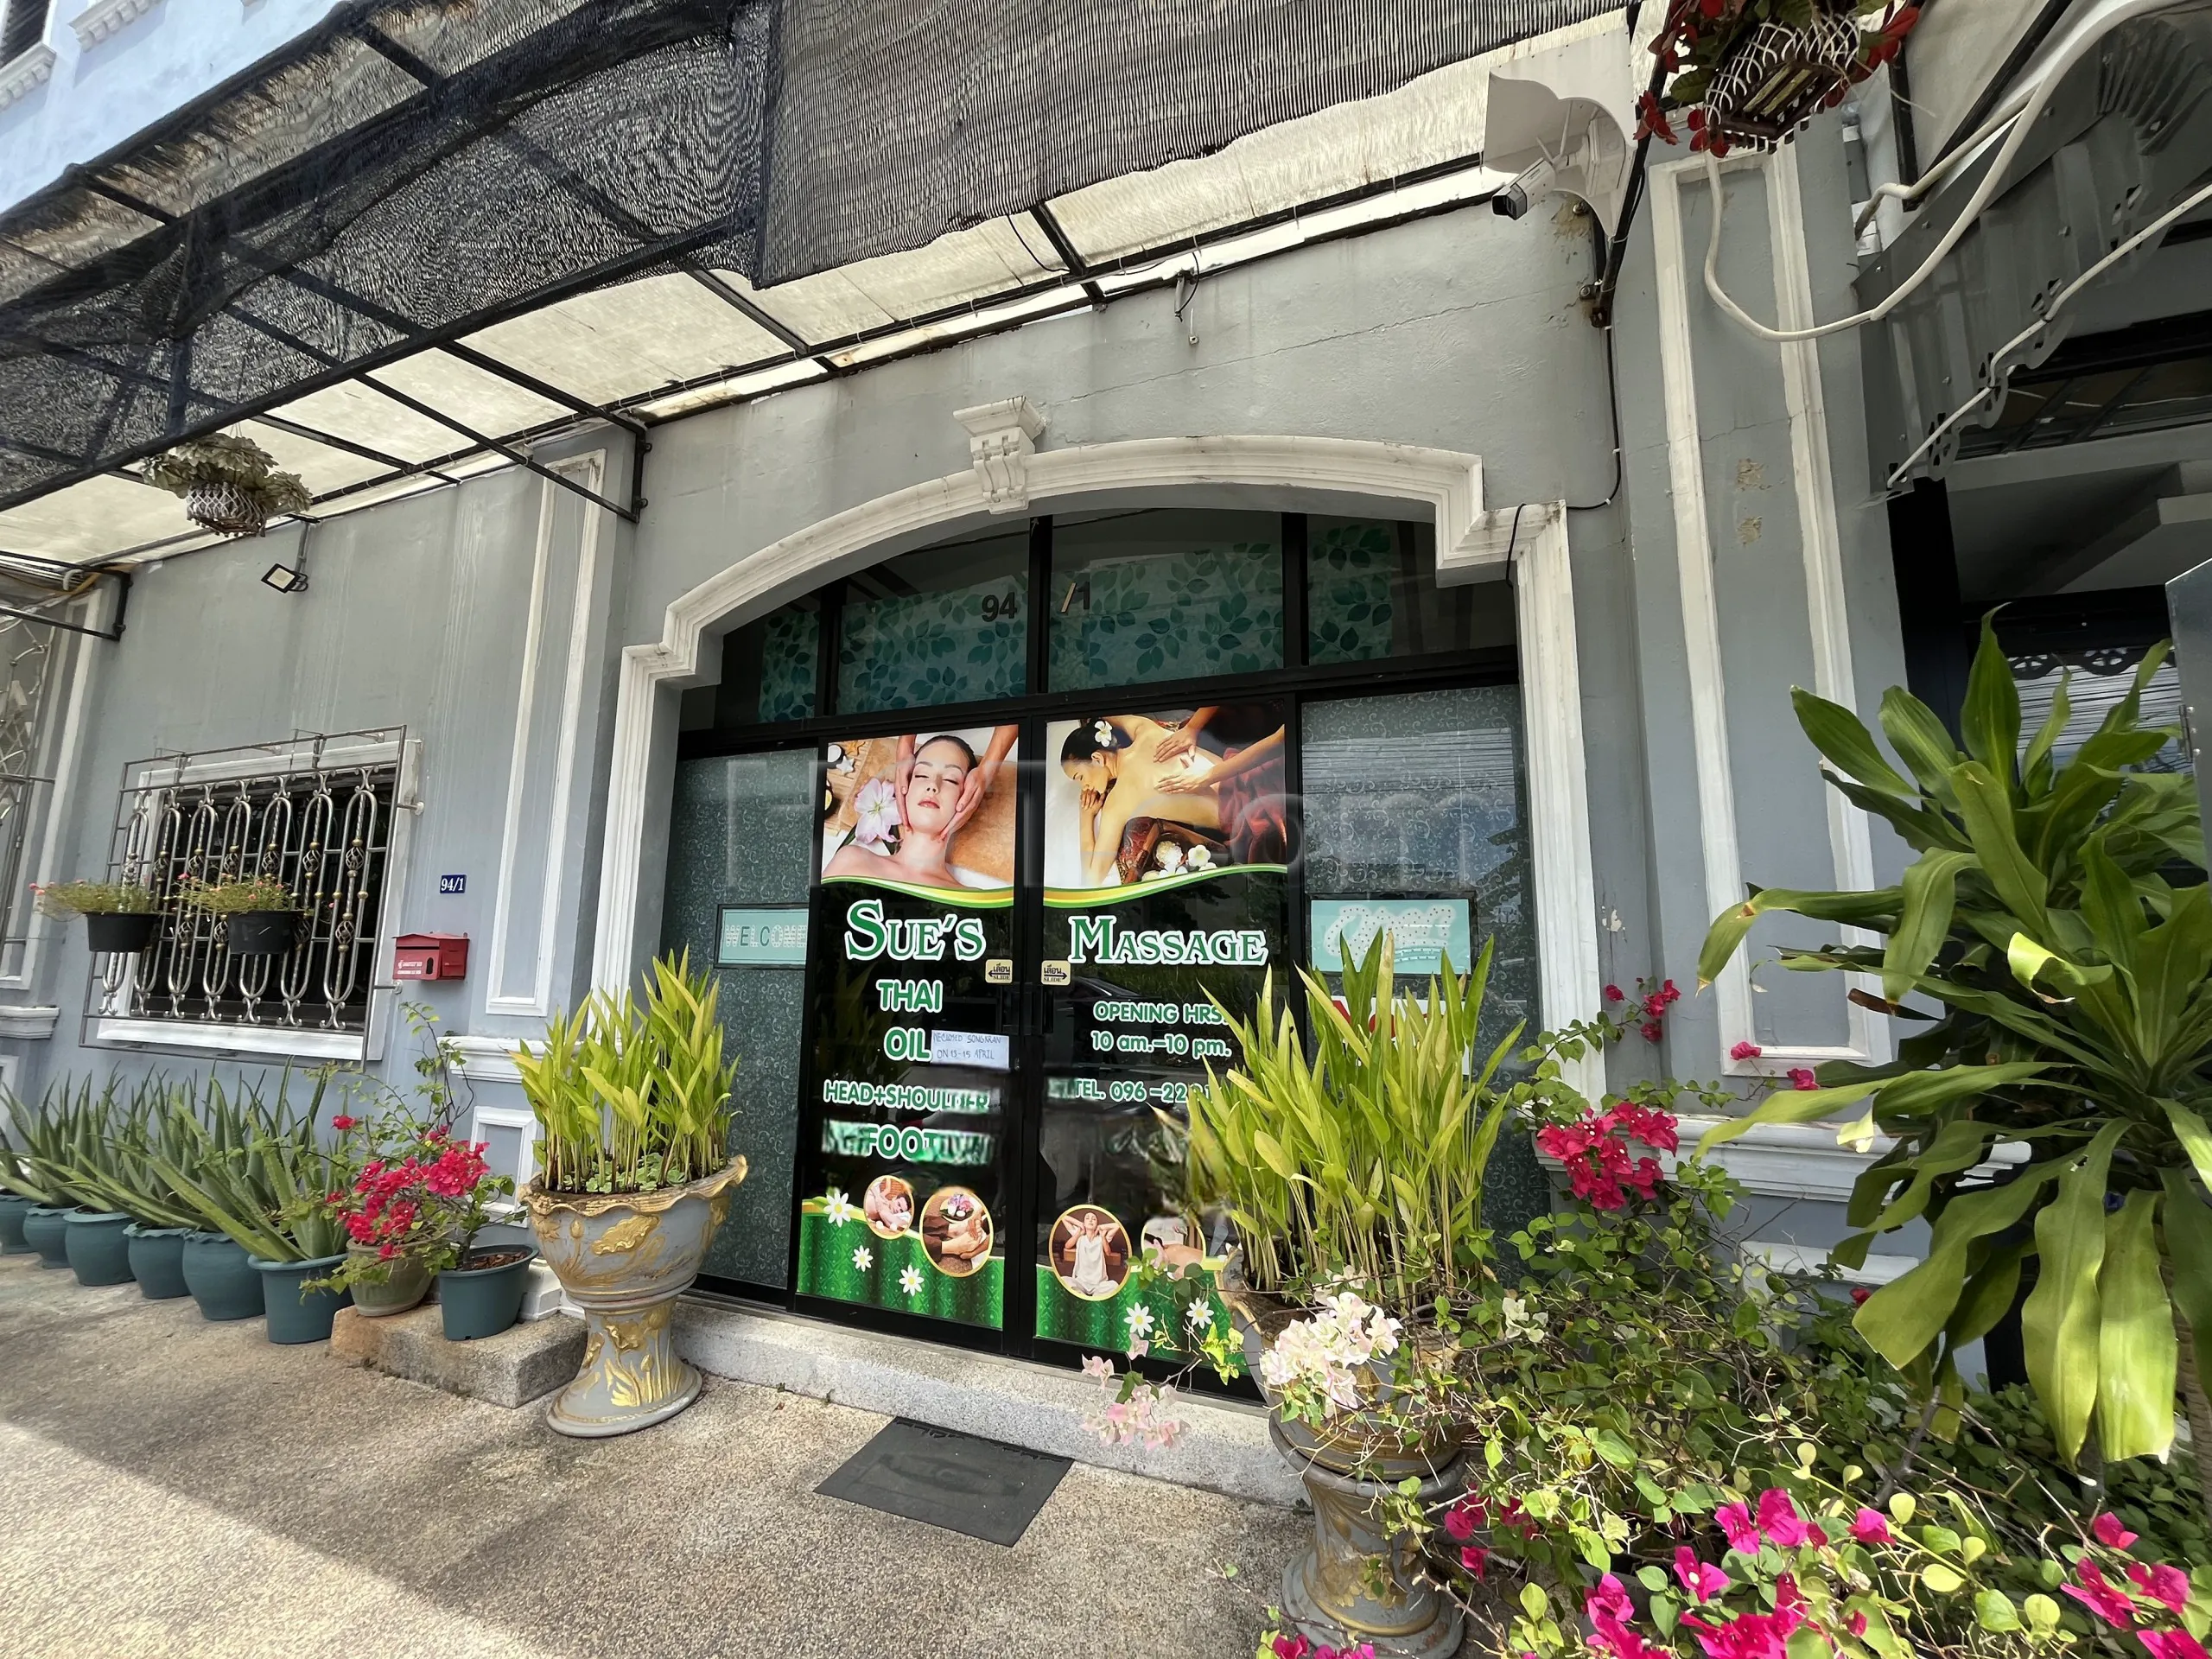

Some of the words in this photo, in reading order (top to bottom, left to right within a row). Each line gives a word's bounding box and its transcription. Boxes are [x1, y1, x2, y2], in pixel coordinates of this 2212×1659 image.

[982, 592, 1017, 622] 94
[441, 877, 464, 892] 94/1
[726, 925, 807, 947] WELCOME
[845, 899, 986, 961] SUE'S
[1068, 915, 1268, 965] MASSAGE
[876, 979, 943, 1013] THAI
[1093, 1001, 1179, 1023] OPENING
[884, 1027, 932, 1062] OIL
[937, 1049, 949, 1058] ON
[975, 1048, 995, 1059] APRIL
[1091, 1031, 1114, 1052] 10
[1192, 1039, 1232, 1059] pm.
[1077, 1078, 1106, 1100] TEL.
[1109, 1081, 1147, 1102] 096
[865, 1124, 940, 1160] FOOT
